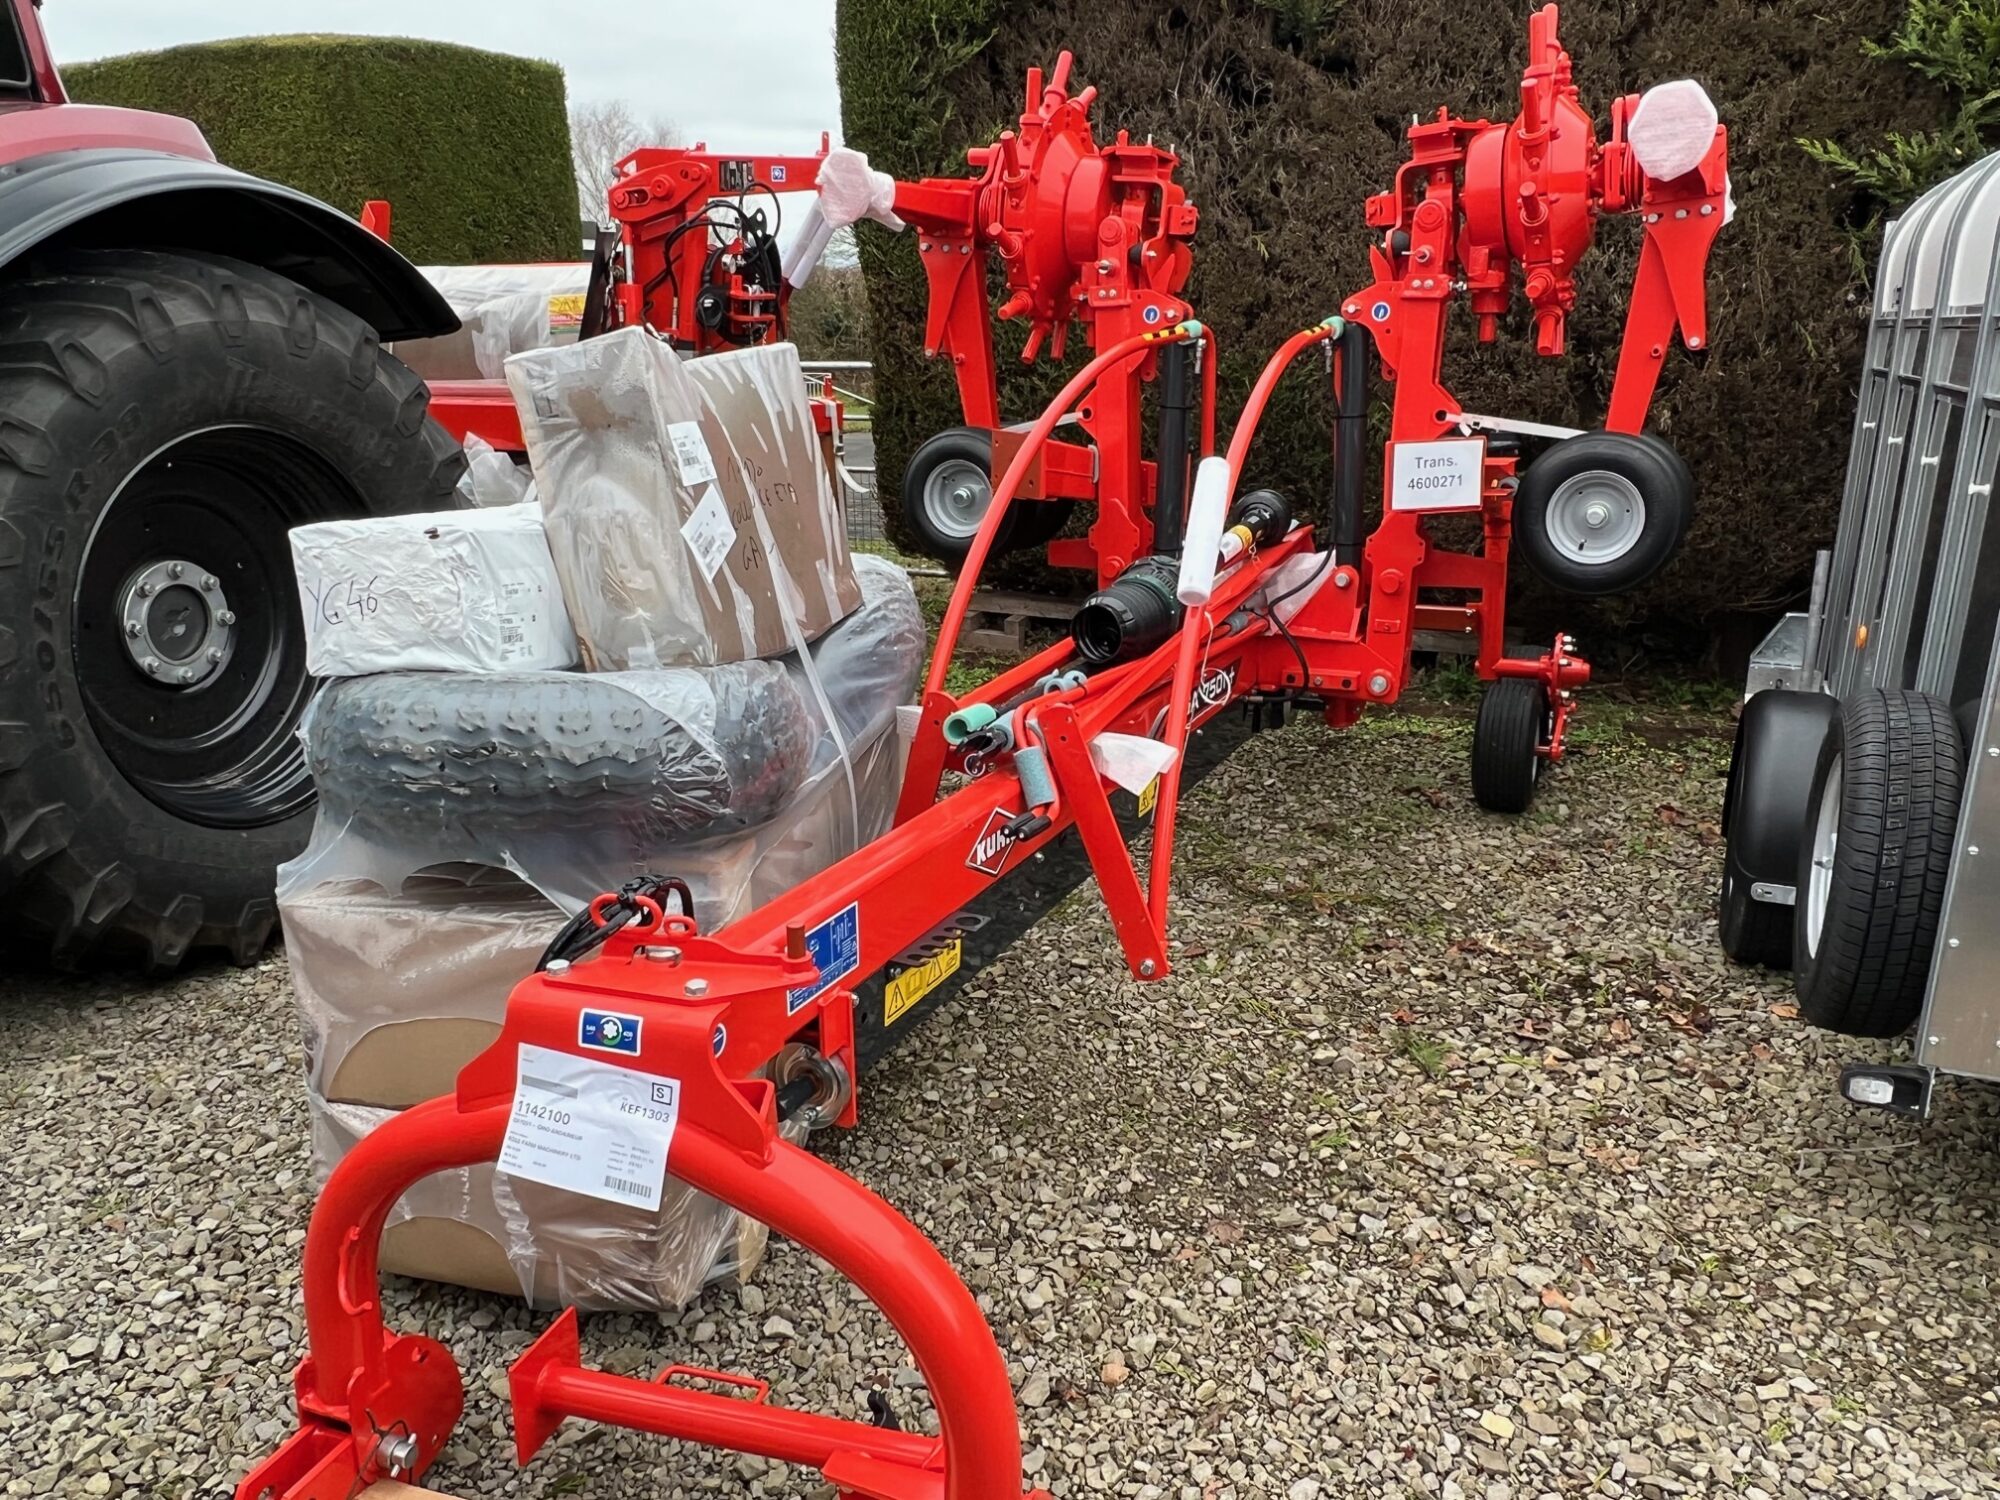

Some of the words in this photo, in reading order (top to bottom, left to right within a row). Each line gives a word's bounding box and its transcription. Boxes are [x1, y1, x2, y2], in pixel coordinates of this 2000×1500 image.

[1414, 456, 1458, 469] Trans.
[1407, 473, 1463, 490] 4600271
[976, 828, 1015, 866] KUH
[517, 1100, 571, 1125] 1142100
[620, 1102, 670, 1123] KEF1303
